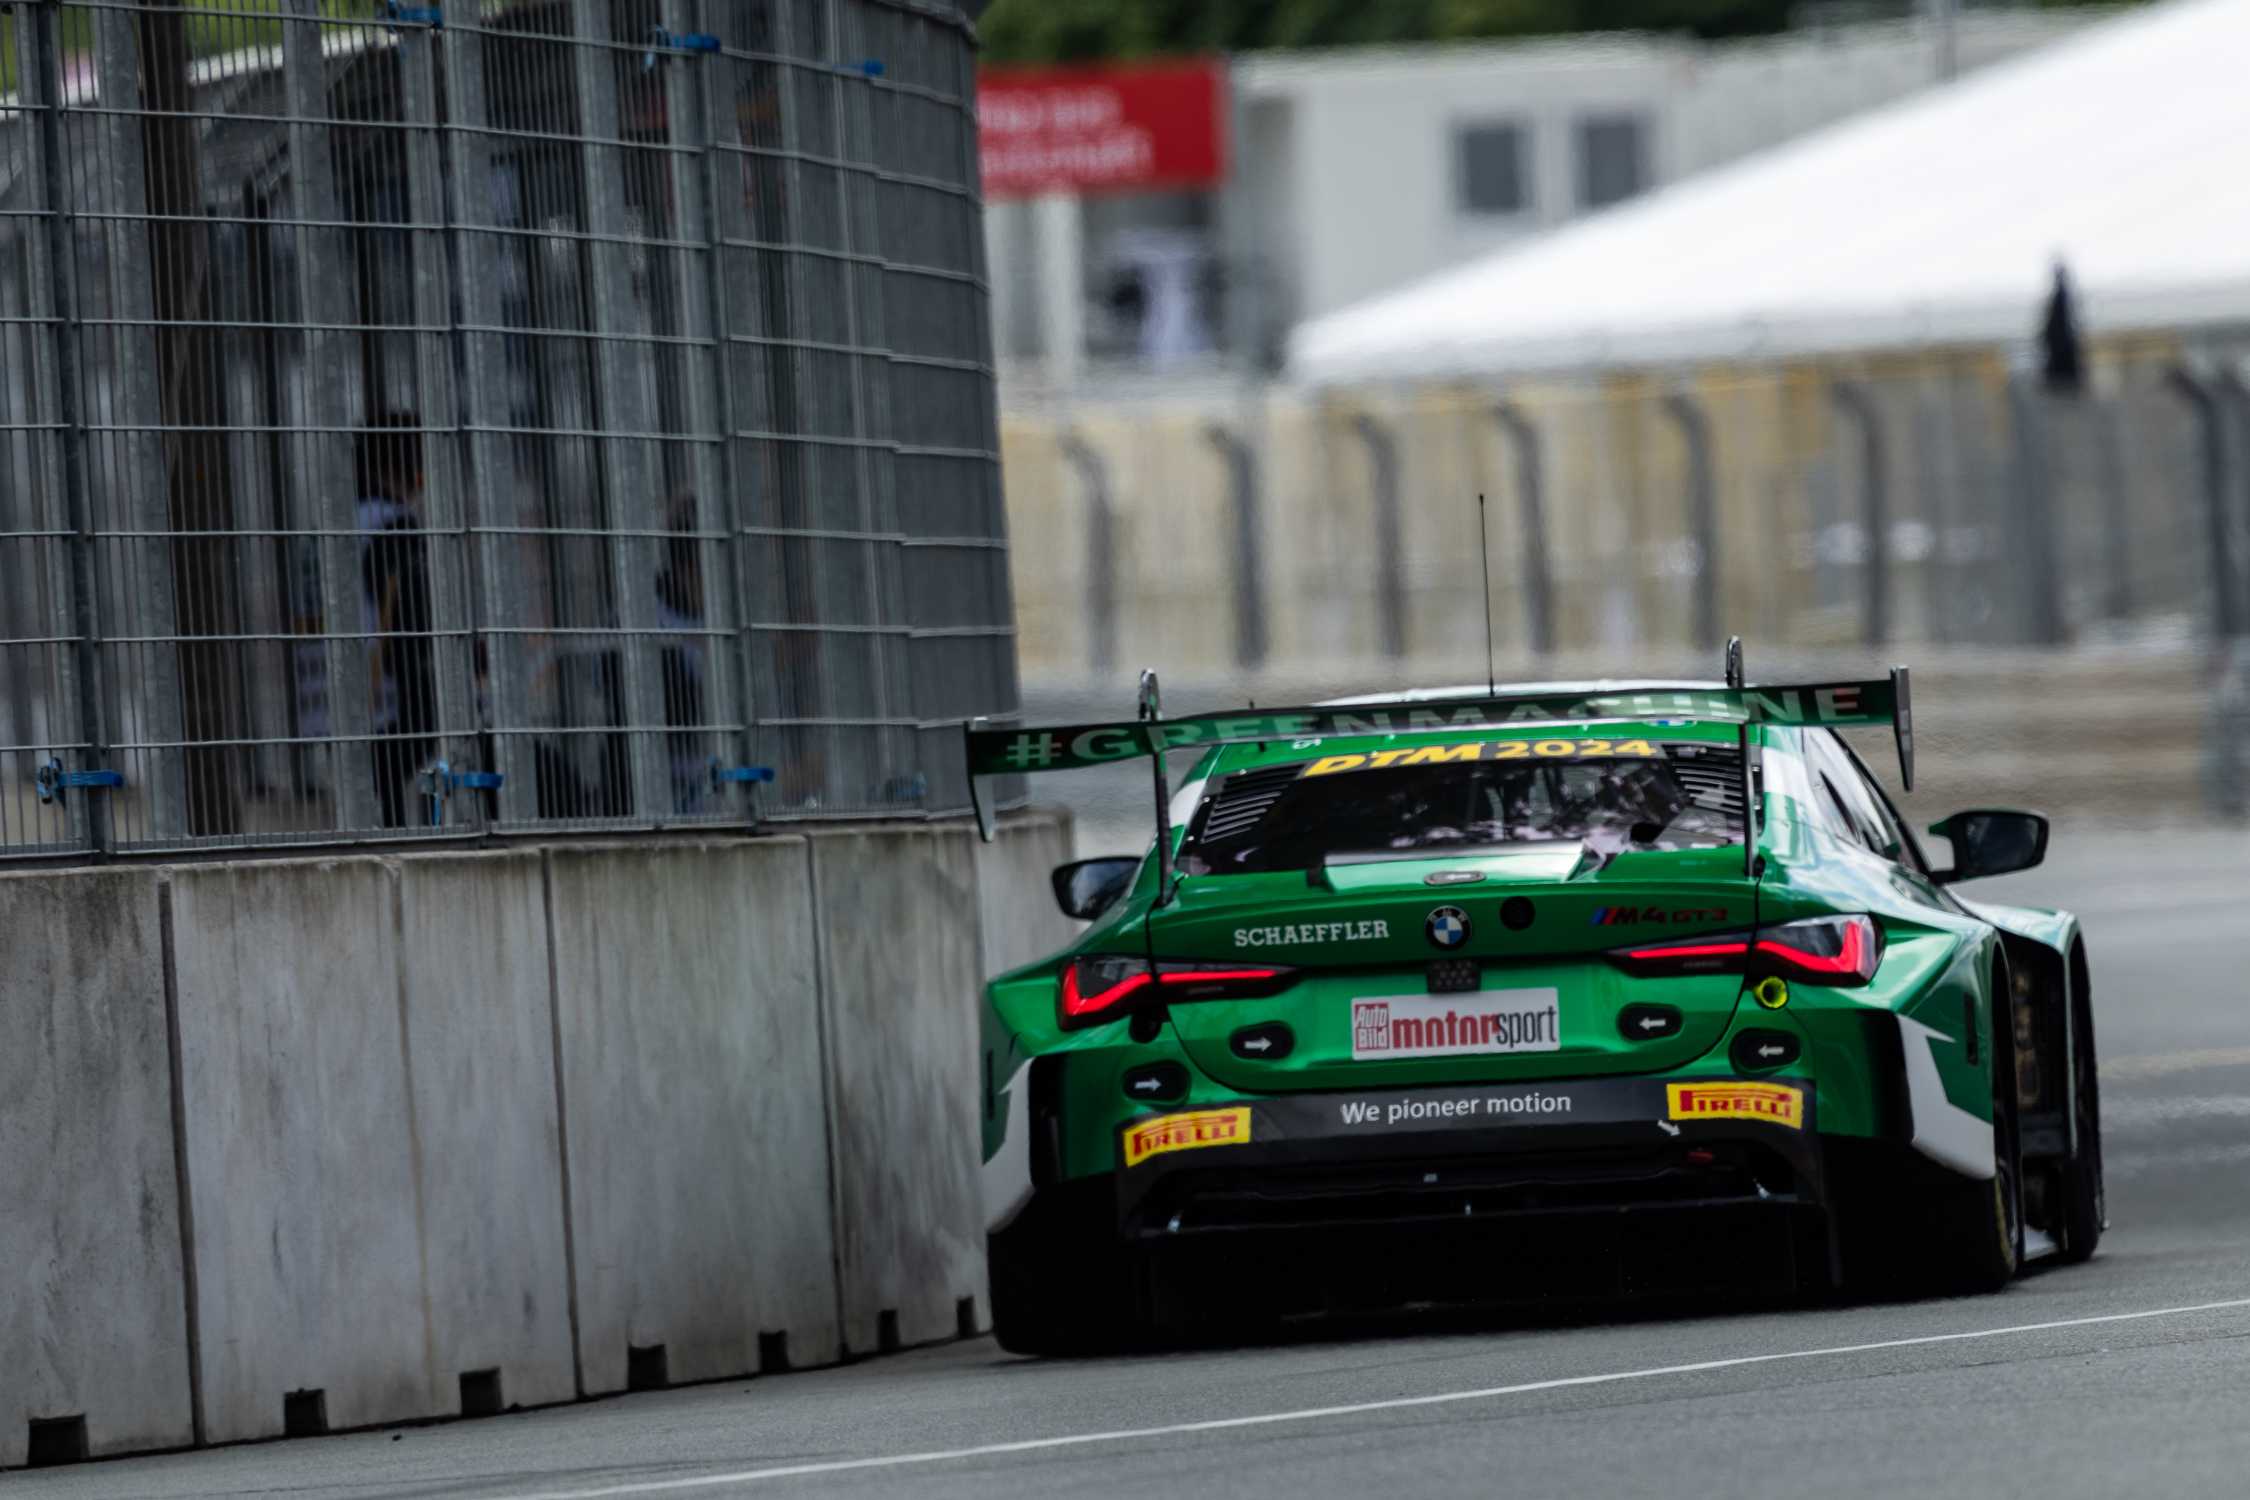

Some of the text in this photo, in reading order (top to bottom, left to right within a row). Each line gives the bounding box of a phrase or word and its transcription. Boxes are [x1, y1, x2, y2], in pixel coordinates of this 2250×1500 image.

[1304, 740, 1656, 777] DTM 2024
[1234, 920, 1389, 947] SCHAEFFLER
[1392, 1005, 1557, 1048] motorsport
[1341, 1093, 1571, 1124] We pioneer motion
[1679, 1089, 1792, 1118] PIRELLI
[1133, 1114, 1237, 1157] PIRELLI
